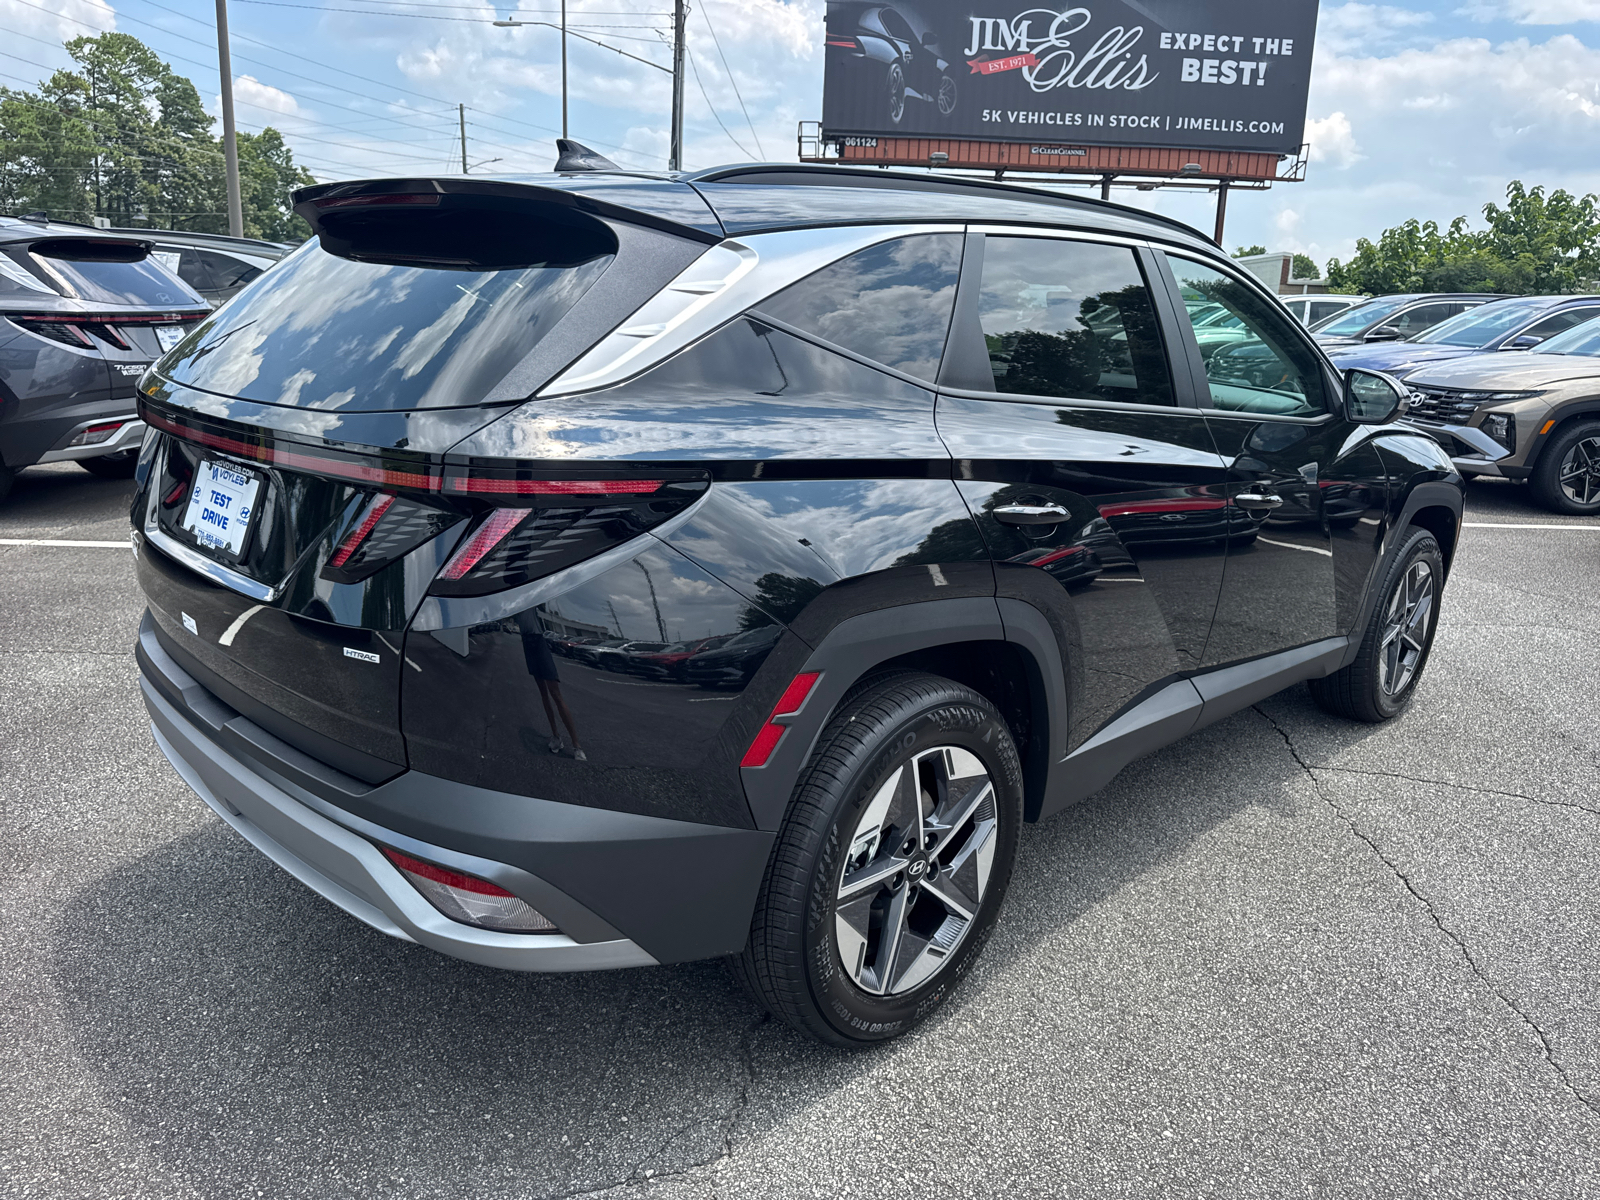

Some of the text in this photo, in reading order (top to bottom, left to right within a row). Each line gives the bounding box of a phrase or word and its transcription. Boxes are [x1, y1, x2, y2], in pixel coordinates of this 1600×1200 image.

[964, 7, 1160, 93] JIM Ellis
[1159, 32, 1294, 56] EXPECT THE
[988, 57, 1027, 71] EST. 1971
[1181, 57, 1268, 86] BEST!
[981, 109, 1284, 134] 5K VEHICLES IN STOCK JIMELLIS.COM
[845, 137, 877, 147] 061124
[219, 469, 245, 486] VOYLES
[210, 489, 232, 509] TEST
[201, 507, 229, 530] DRIVE
[346, 649, 377, 662] HTRAC
[830, 999, 902, 1033] 235/60 R18 103H
